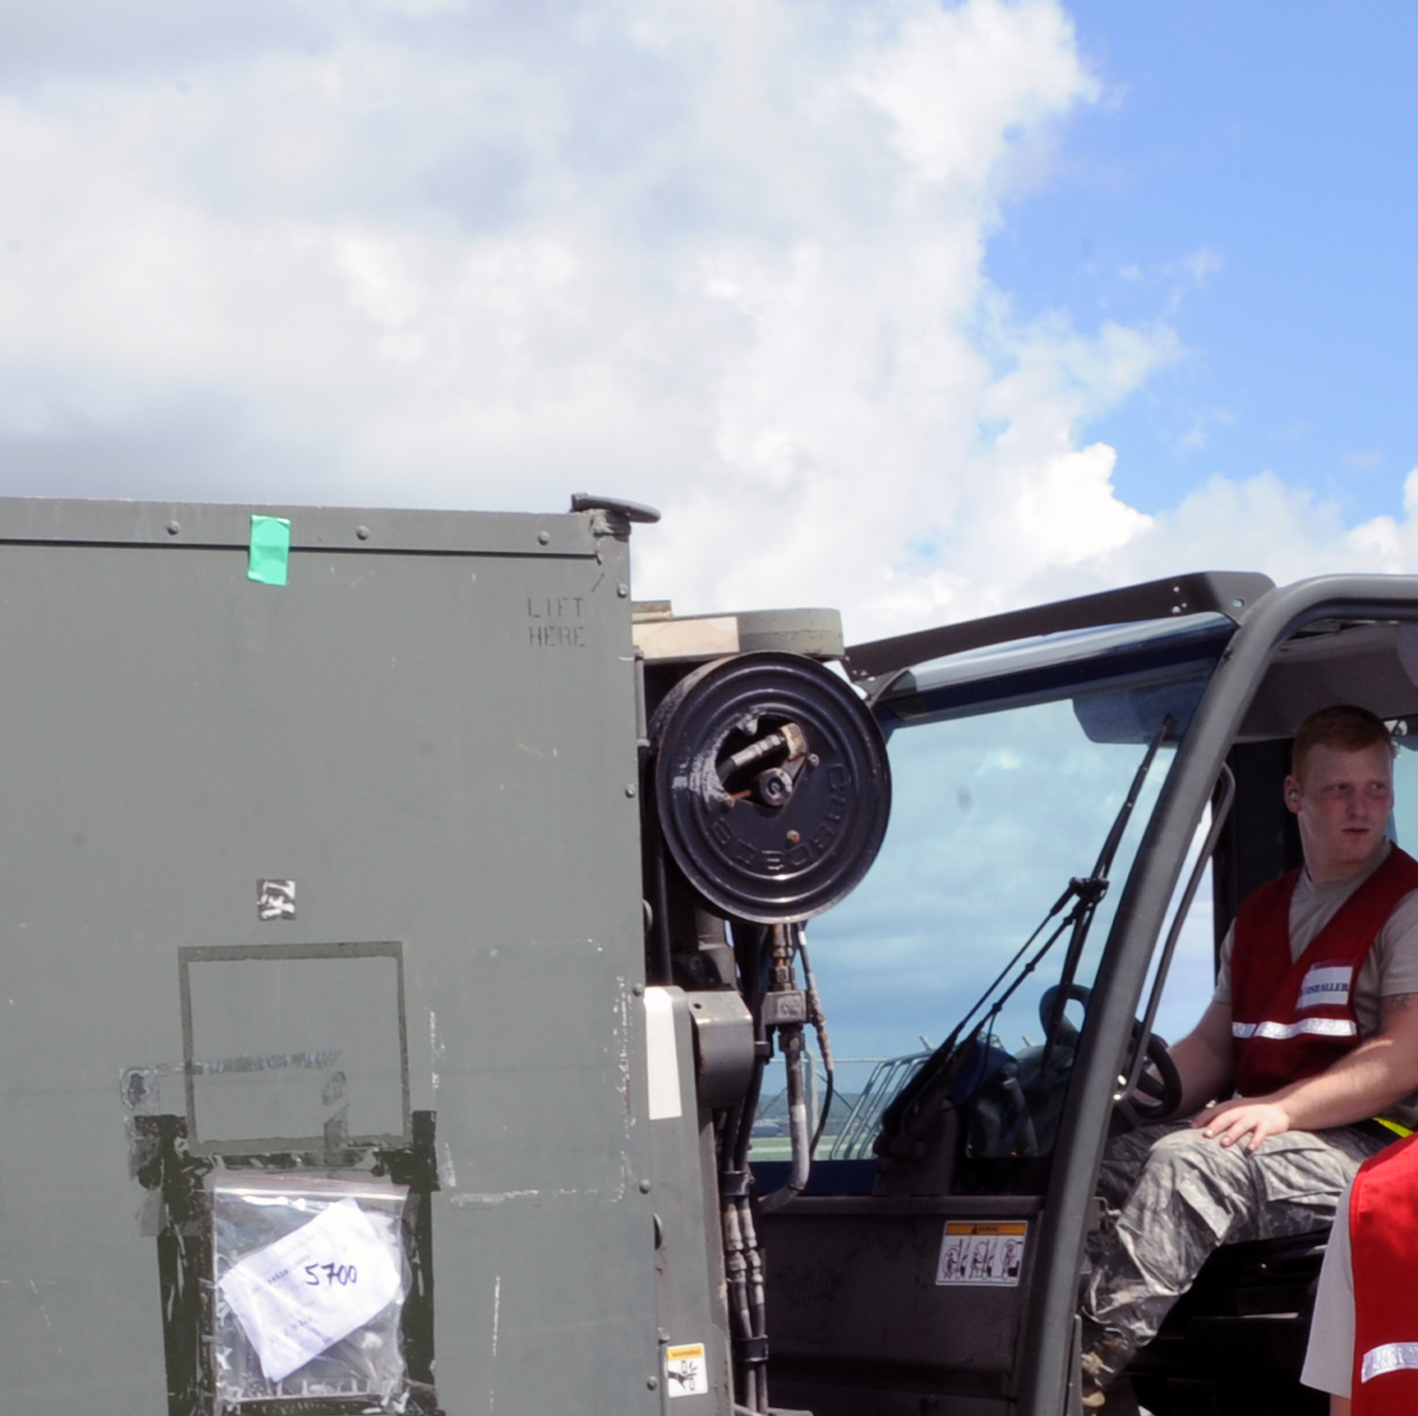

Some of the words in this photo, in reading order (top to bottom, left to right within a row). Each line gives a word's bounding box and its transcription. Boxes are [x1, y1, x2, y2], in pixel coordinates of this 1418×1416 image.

[527, 597, 583, 619] LIFT
[529, 626, 586, 647] HERE
[304, 1262, 357, 1287] 5700
